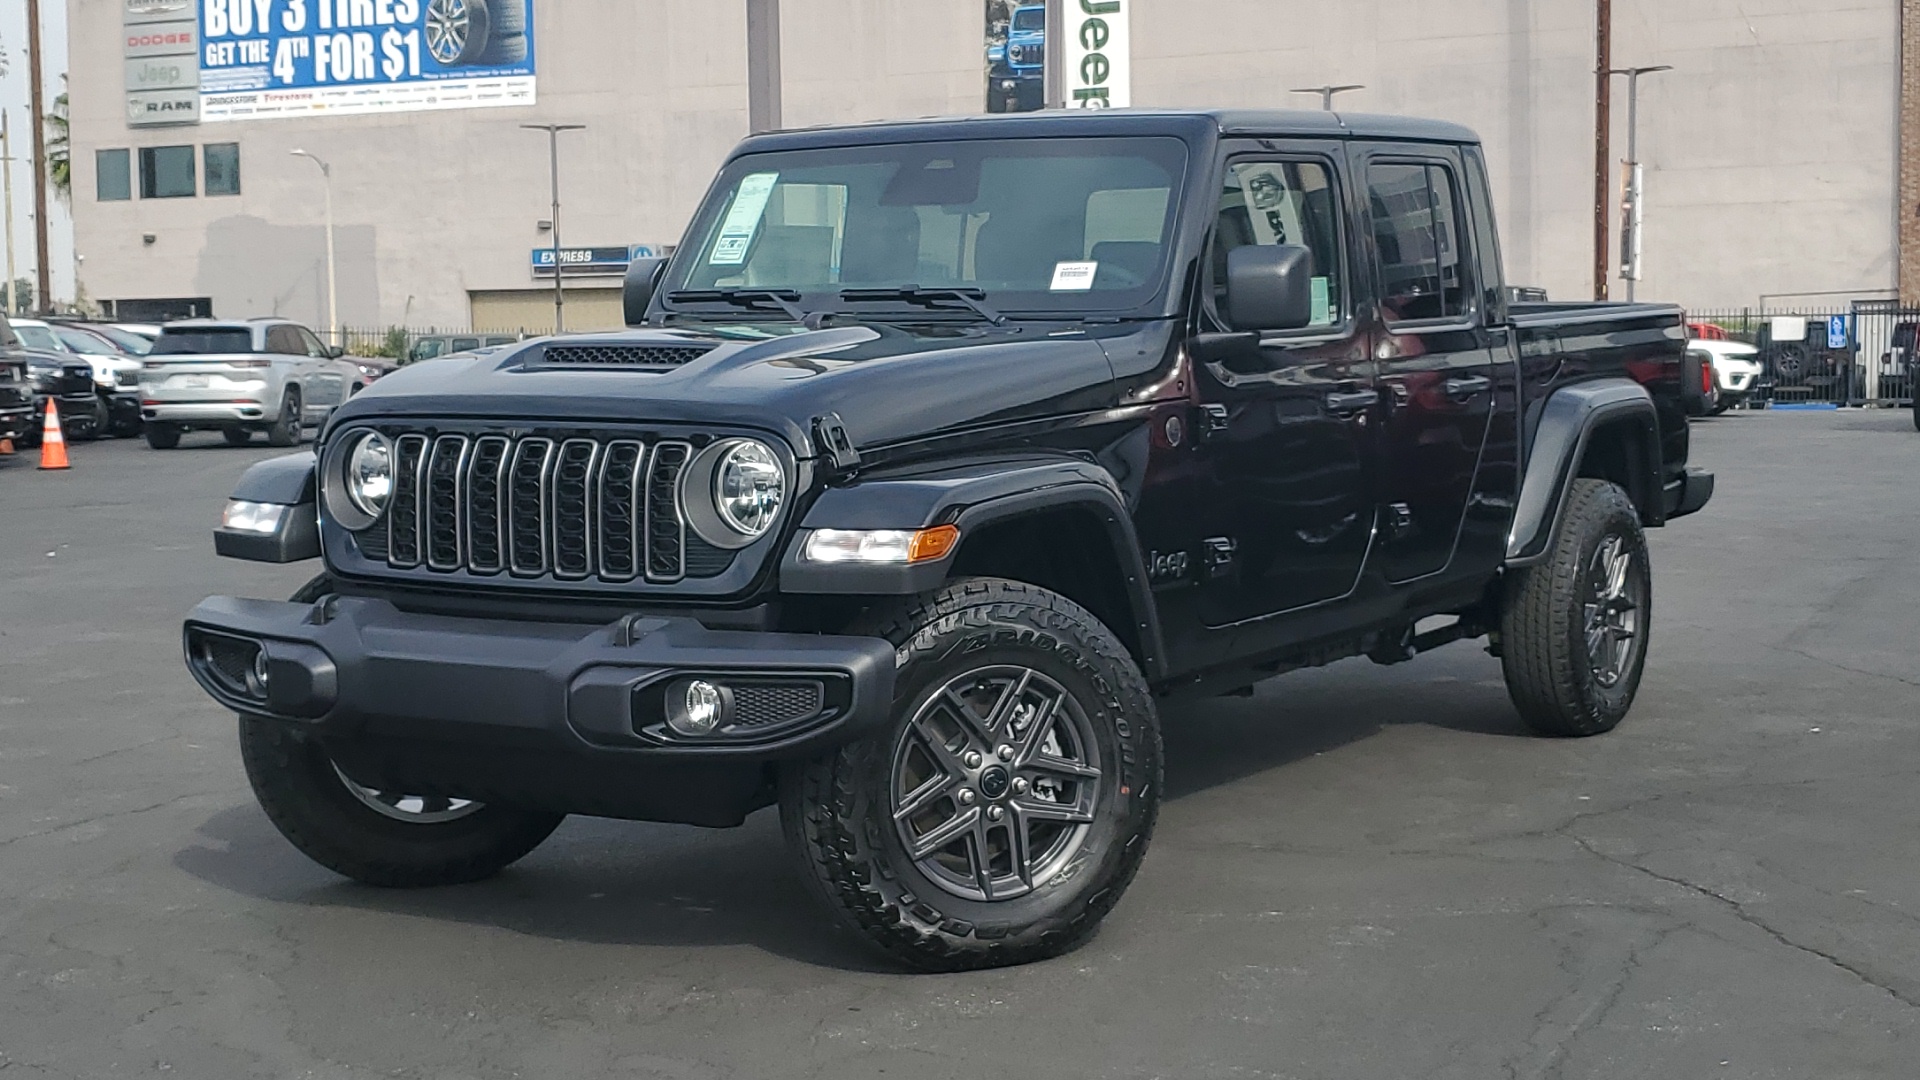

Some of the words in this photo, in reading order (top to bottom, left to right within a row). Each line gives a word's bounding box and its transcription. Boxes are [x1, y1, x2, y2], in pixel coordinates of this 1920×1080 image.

[204, 0, 272, 37] BUY
[282, 0, 306, 32] 3
[128, 33, 191, 47] DODGE
[205, 41, 236, 66] GET
[238, 39, 270, 63] THE
[273, 36, 310, 84] 4TH
[315, 32, 375, 82] FOR
[381, 27, 420, 81] $1
[138, 64, 181, 84] Jeep
[147, 101, 193, 112] RAM
[541, 251, 592, 263] EXPRESS
[1147, 550, 1187, 577] Jeep
